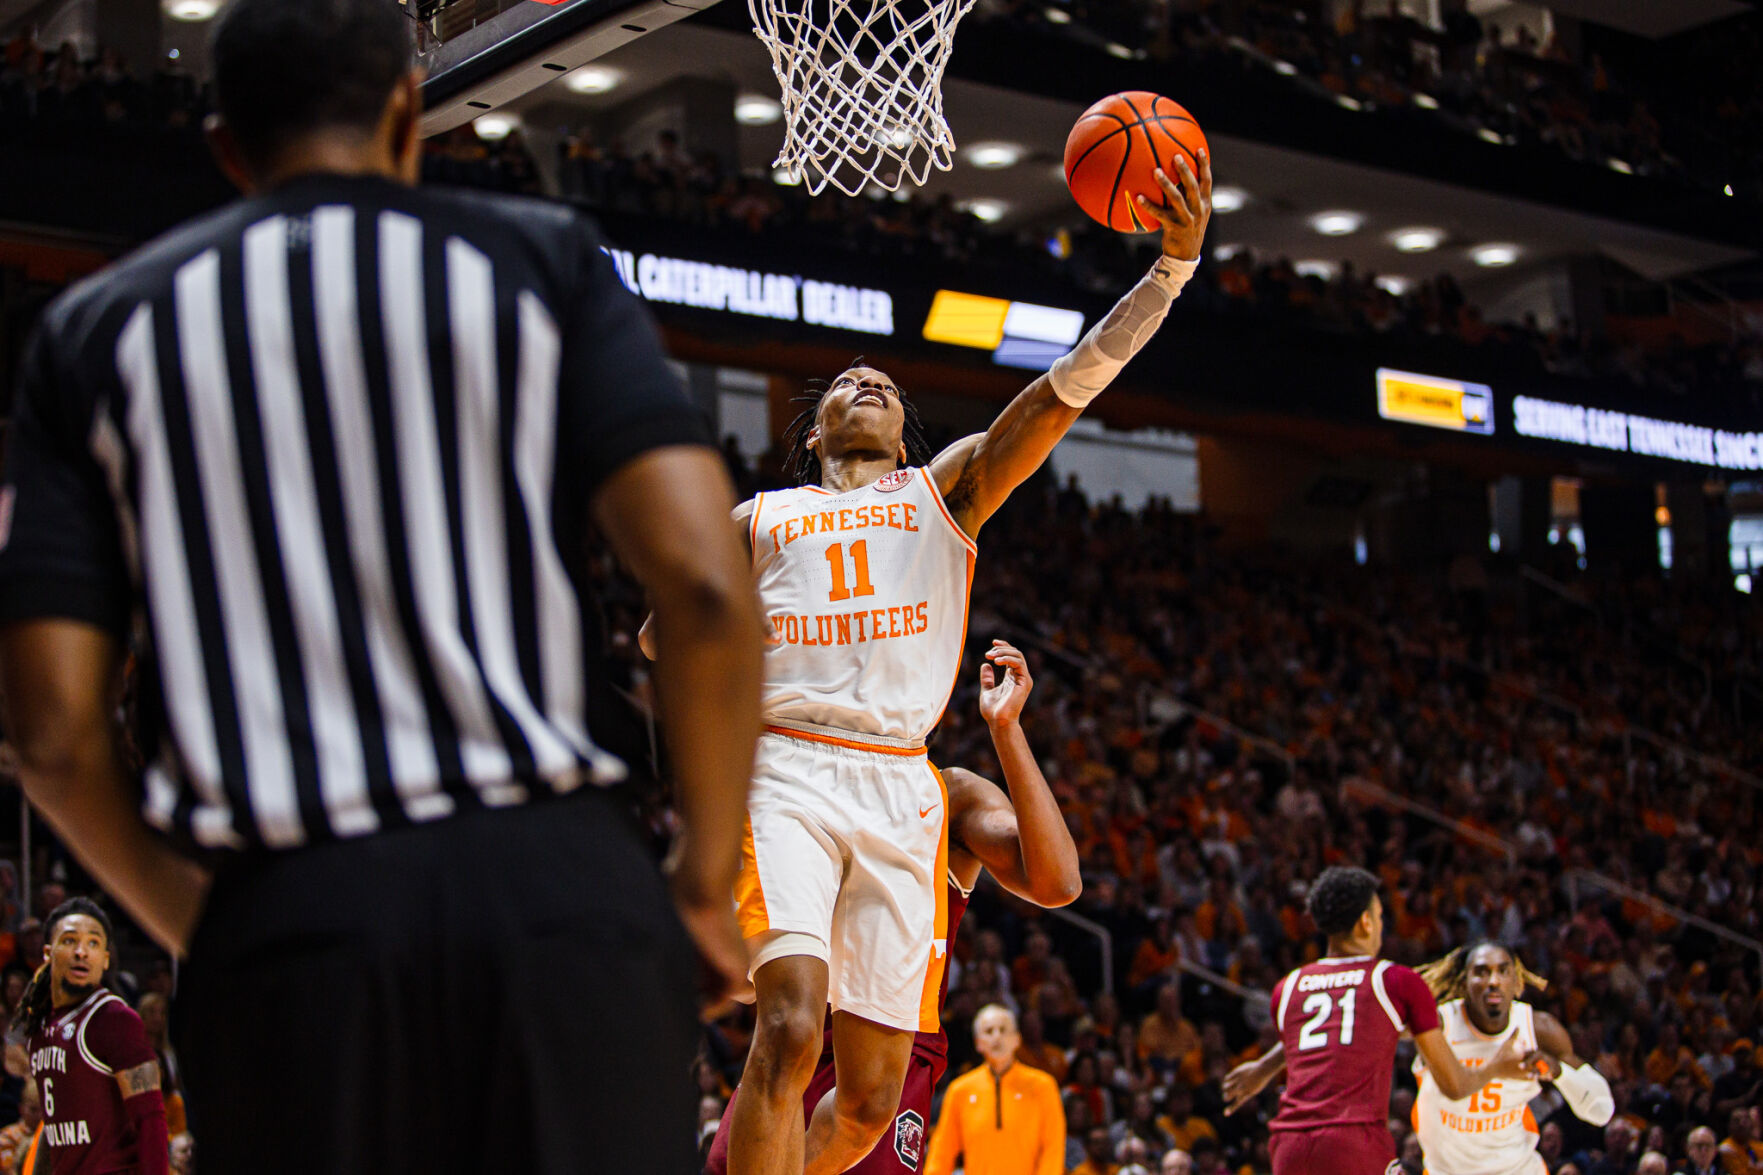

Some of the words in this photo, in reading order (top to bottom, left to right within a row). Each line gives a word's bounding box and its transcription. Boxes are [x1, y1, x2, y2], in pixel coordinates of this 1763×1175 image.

[637, 253, 799, 322] CATERPILLAR
[802, 280, 895, 336] DEALER
[1513, 394, 1587, 445] SERVING
[1587, 407, 1628, 452] EAST
[1627, 414, 1716, 466] TENNESSEE
[1714, 429, 1763, 471] SINC
[769, 502, 919, 554] TENNESSEE
[825, 539, 875, 602] 11
[771, 601, 928, 646] VOLUNTEERS
[1298, 988, 1356, 1051] 21
[31, 1045, 67, 1077] SOUTH
[43, 1077, 55, 1118] 6
[1467, 1081, 1504, 1113] 15
[44, 1120, 92, 1147] OLINA
